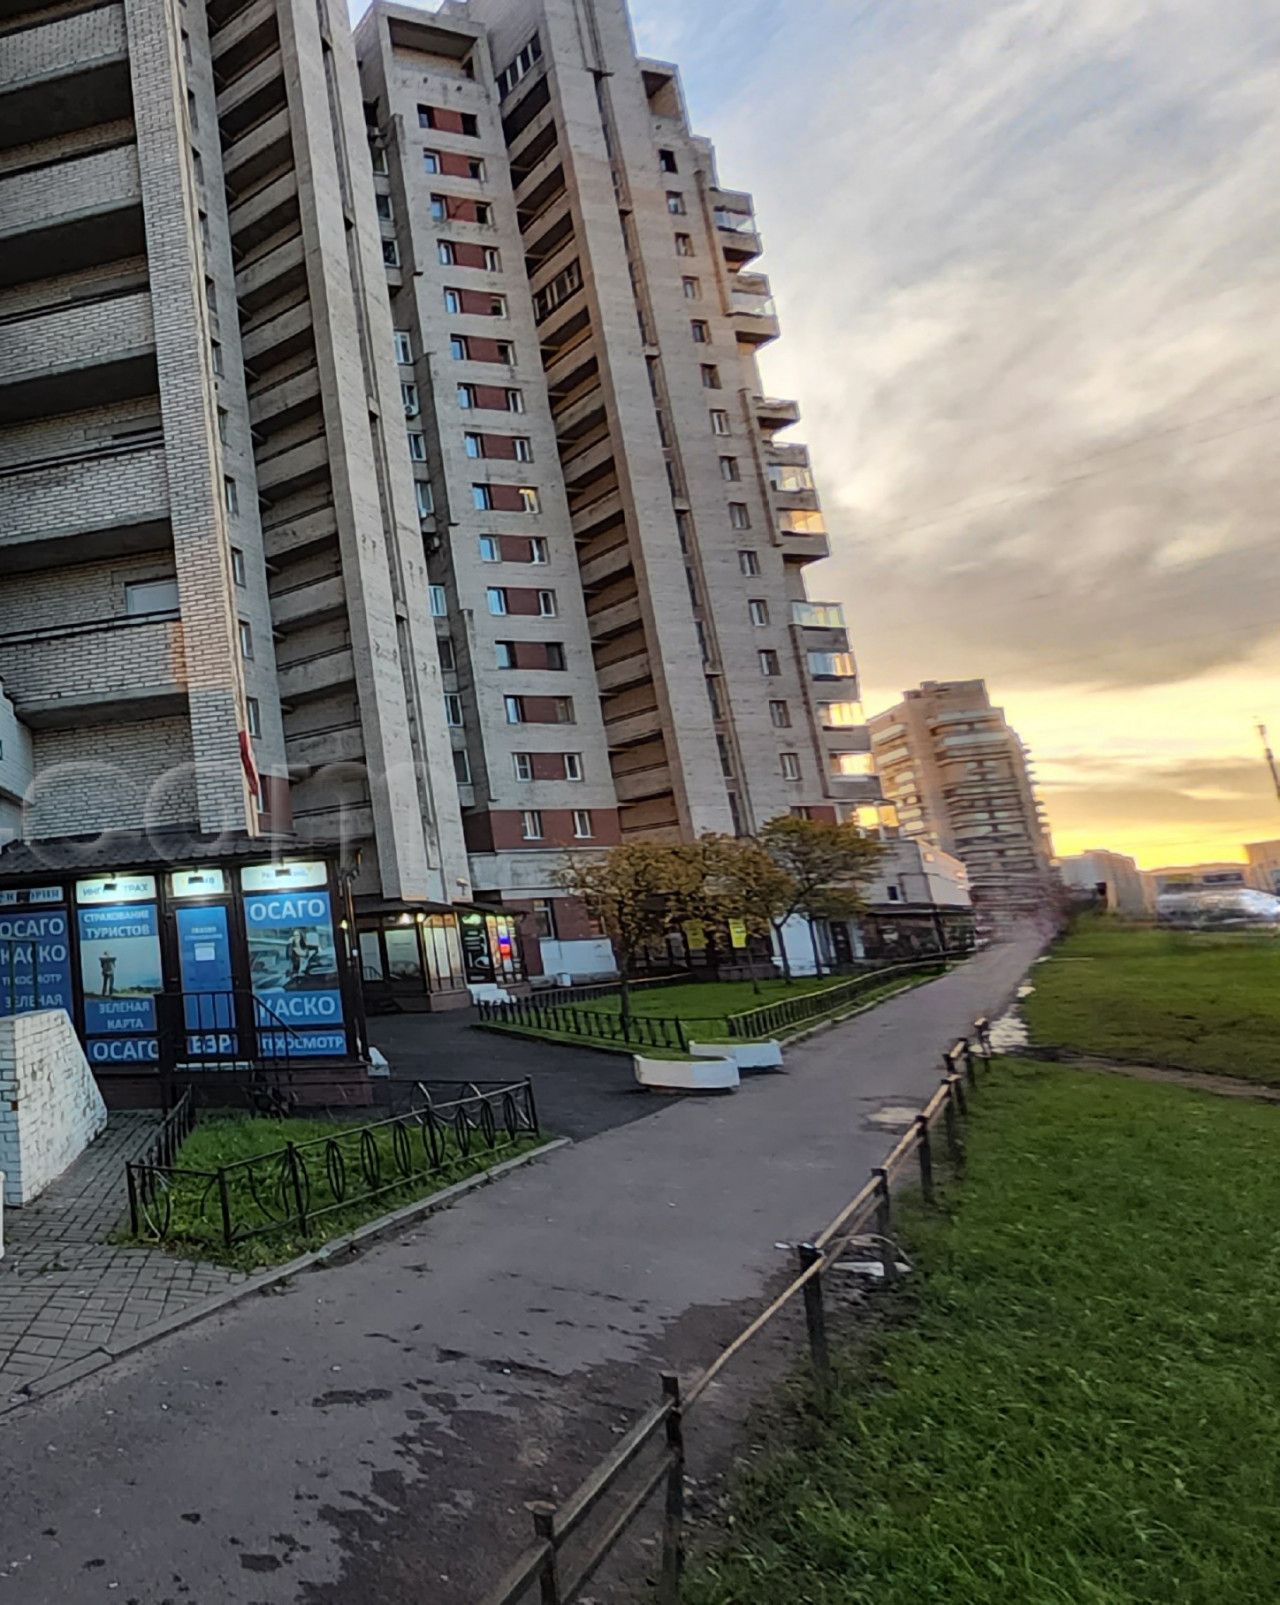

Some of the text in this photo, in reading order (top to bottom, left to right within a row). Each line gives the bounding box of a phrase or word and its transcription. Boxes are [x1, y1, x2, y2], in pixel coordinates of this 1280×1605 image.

[250, 898, 326, 921] ОСАГО
[83, 910, 150, 924] СТРАХОВАНИЕ
[85, 924, 150, 939] ТУРИСТОВ
[98, 1001, 150, 1015] ЗЕЛЕНАЯ
[106, 1017, 145, 1031] КАРТА
[93, 1040, 160, 1060] ОСАГО
